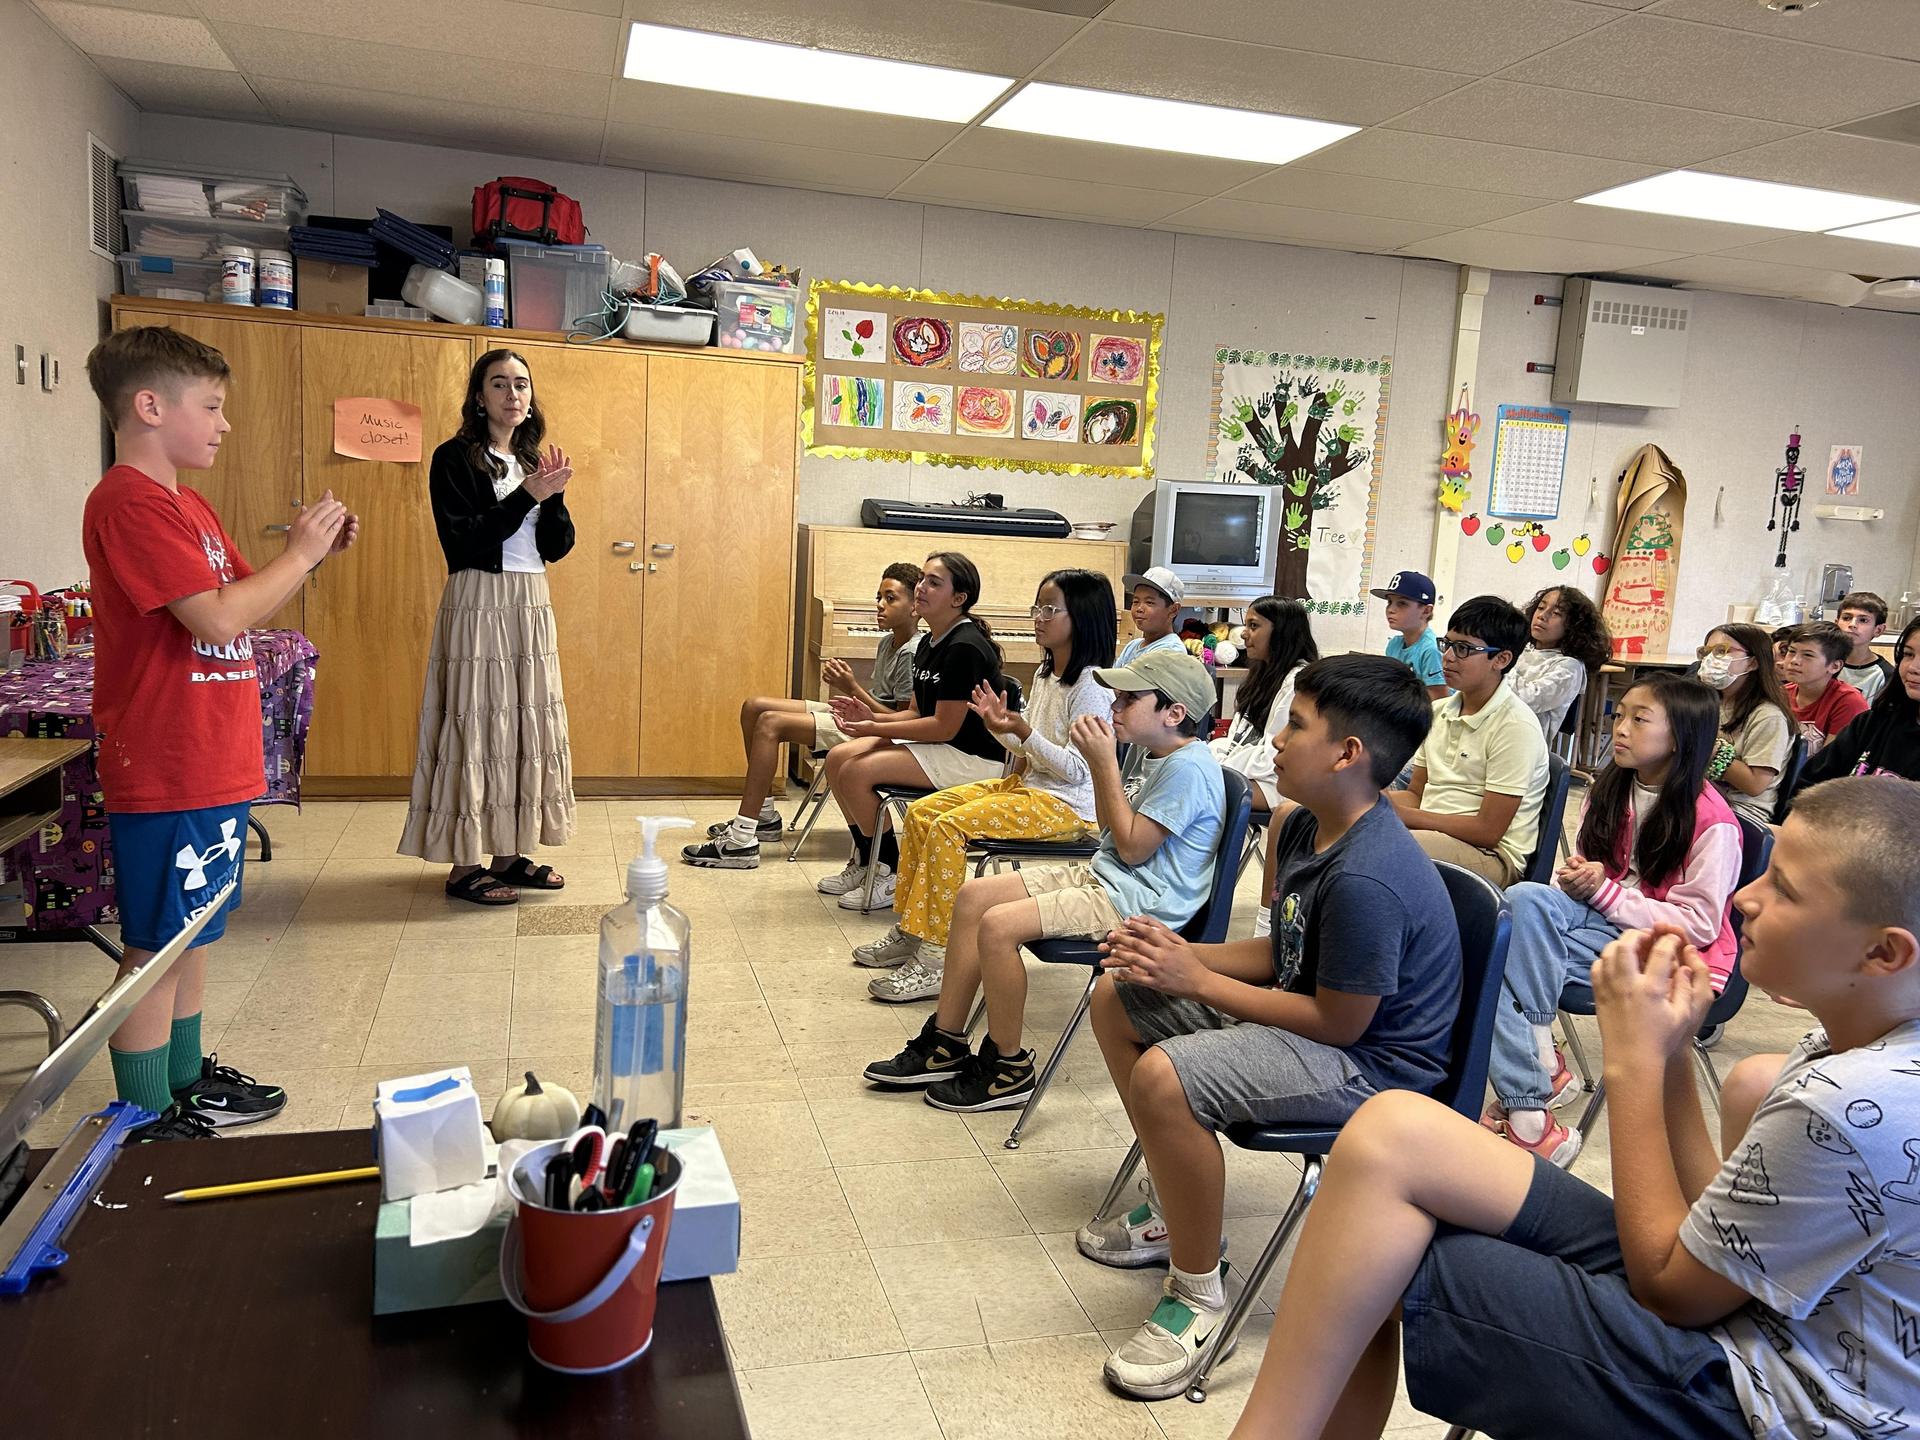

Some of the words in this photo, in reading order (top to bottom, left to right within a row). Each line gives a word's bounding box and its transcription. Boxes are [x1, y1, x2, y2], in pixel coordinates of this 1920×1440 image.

[359, 412, 404, 430] Music
[1316, 526, 1346, 544] Tree
[1388, 574, 1402, 590] B
